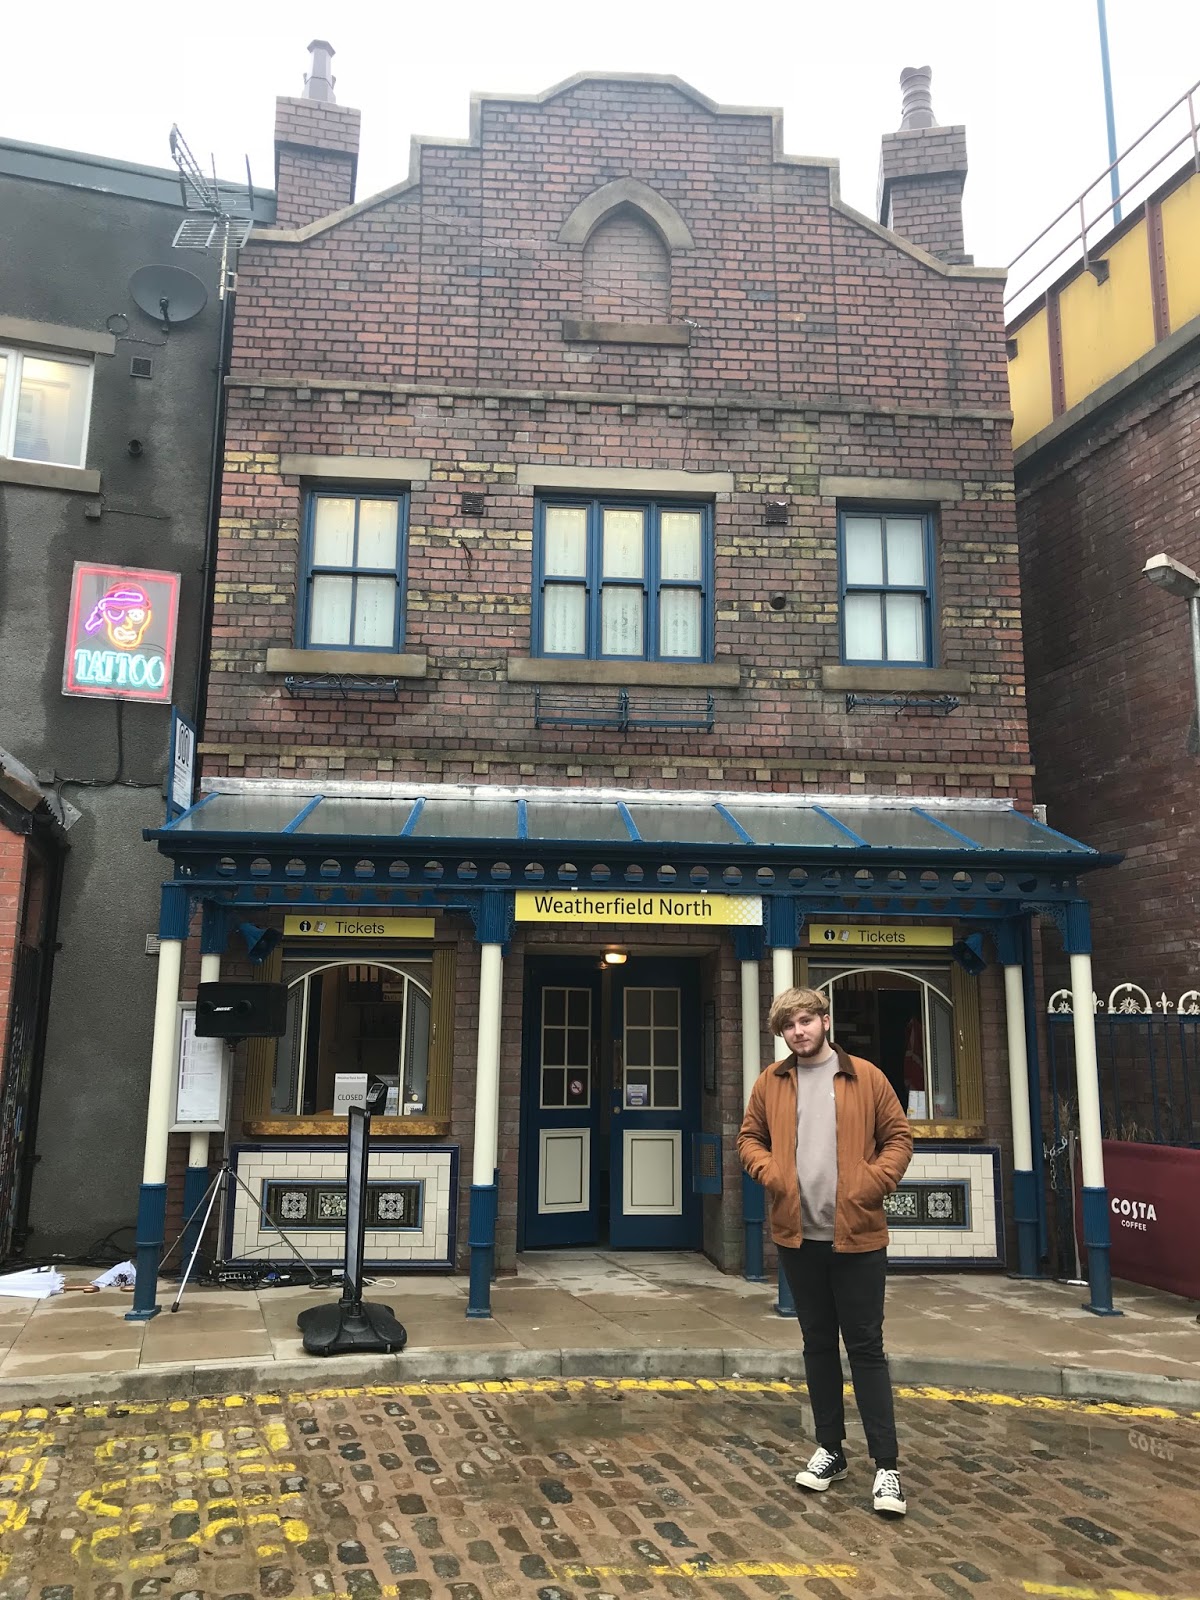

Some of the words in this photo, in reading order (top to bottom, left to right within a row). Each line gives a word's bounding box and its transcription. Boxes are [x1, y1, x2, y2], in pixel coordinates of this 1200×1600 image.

[74, 649, 165, 688] TATTOO
[534, 896, 653, 915] Weatherfield
[659, 898, 712, 917] North
[335, 921, 385, 934] Tickets
[858, 930, 906, 943] Tickets
[1111, 1197, 1157, 1221] COSTA
[1121, 1219, 1147, 1231] COFFEE
